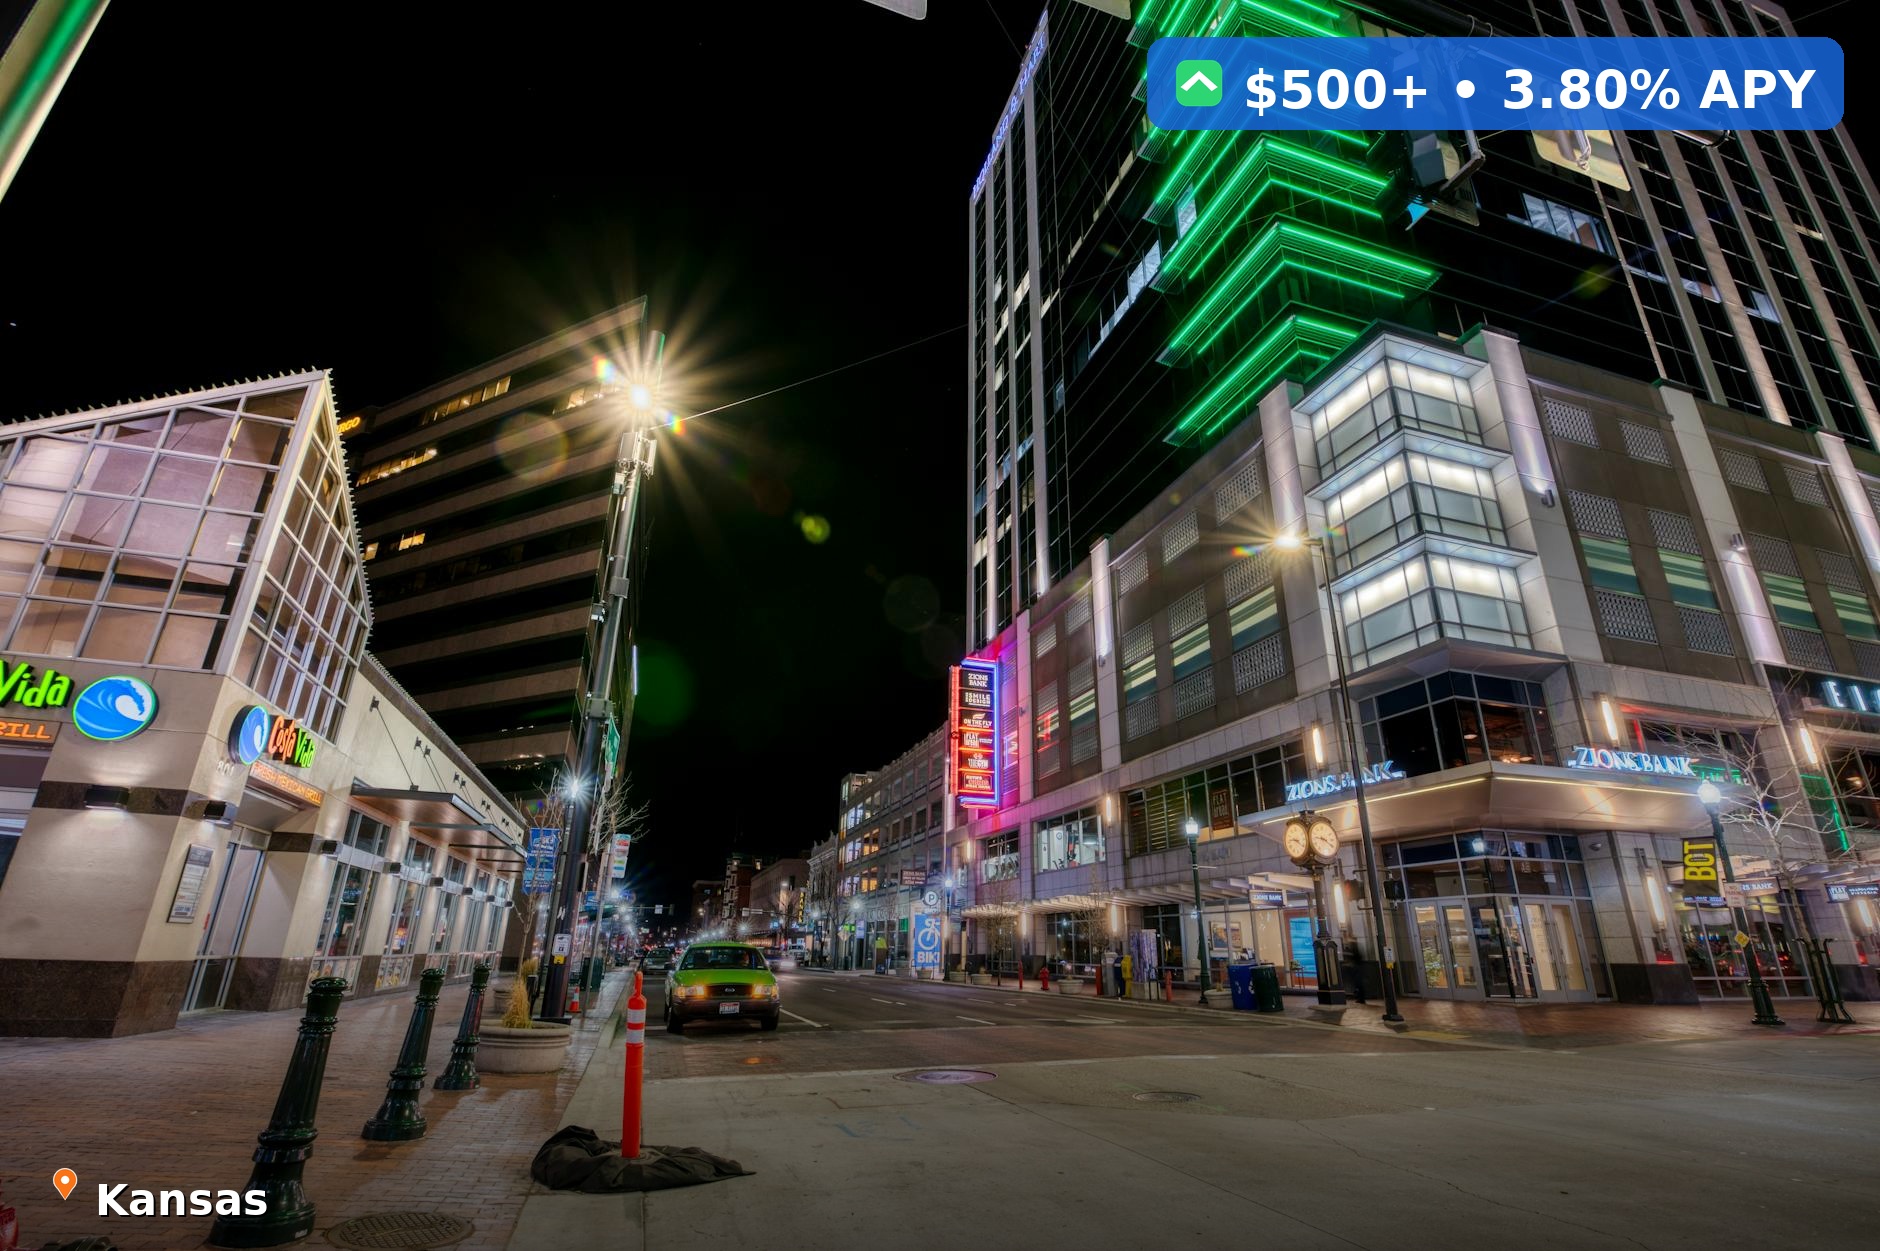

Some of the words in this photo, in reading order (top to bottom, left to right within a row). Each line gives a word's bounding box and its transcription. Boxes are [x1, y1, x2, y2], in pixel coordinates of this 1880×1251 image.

[967, 673, 988, 681] ZIONS
[0, 659, 71, 708] Vida
[969, 680, 988, 688] BANK
[969, 692, 990, 700] SMILE
[268, 715, 296, 761] Costa
[295, 727, 316, 769] Vida
[1573, 745, 1639, 772] ZIONS
[1641, 753, 1696, 777] BANK
[1286, 774, 1337, 801] ZIONS
[1684, 841, 1717, 881] BOT
[1751, 882, 1774, 890] BANK
[928, 893, 935, 902] P
[917, 951, 940, 963] BIK
